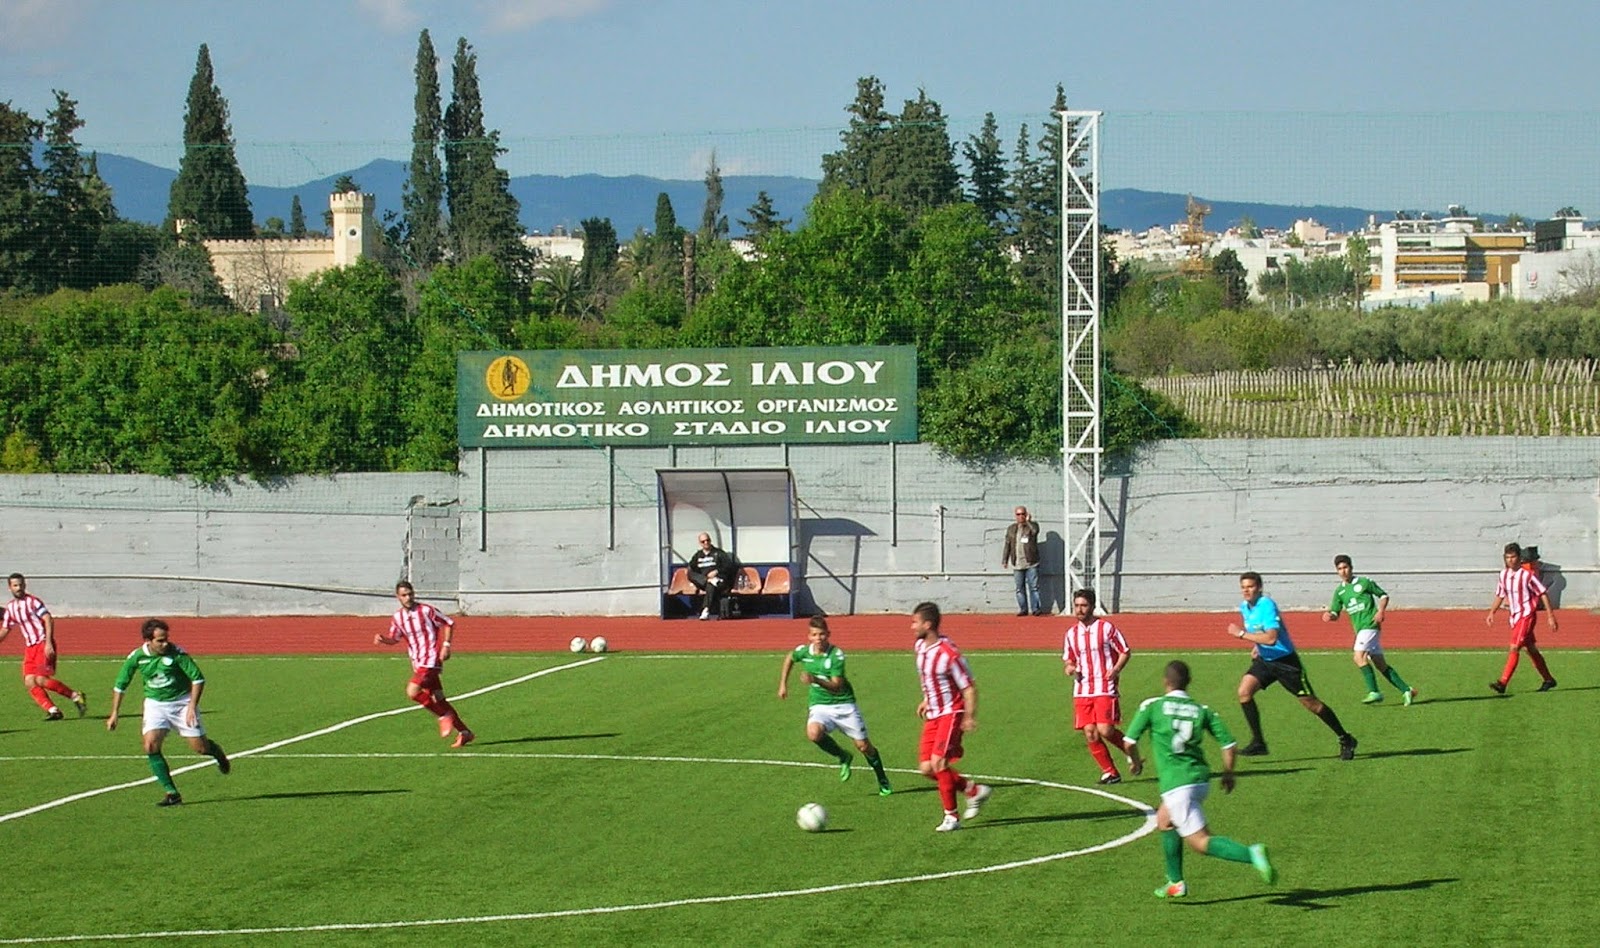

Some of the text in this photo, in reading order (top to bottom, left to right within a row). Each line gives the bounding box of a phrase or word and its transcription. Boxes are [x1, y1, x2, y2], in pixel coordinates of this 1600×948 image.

[556, 360, 885, 388] ΔΗΜΟΣ ΙΛΙΟΥ
[476, 398, 898, 417] ΔΗΜΟΤΙΚΟΣ ΑΘΛΗΤΙΚΟΣ ΟΡΓΑΝΙΣΜΟΣ
[483, 419, 891, 438] ΔΗΜΟΤΙΚΟ ΣΤΑΔΙΟ ΙΛΙΟΥ
[1171, 719, 1194, 754] 7
